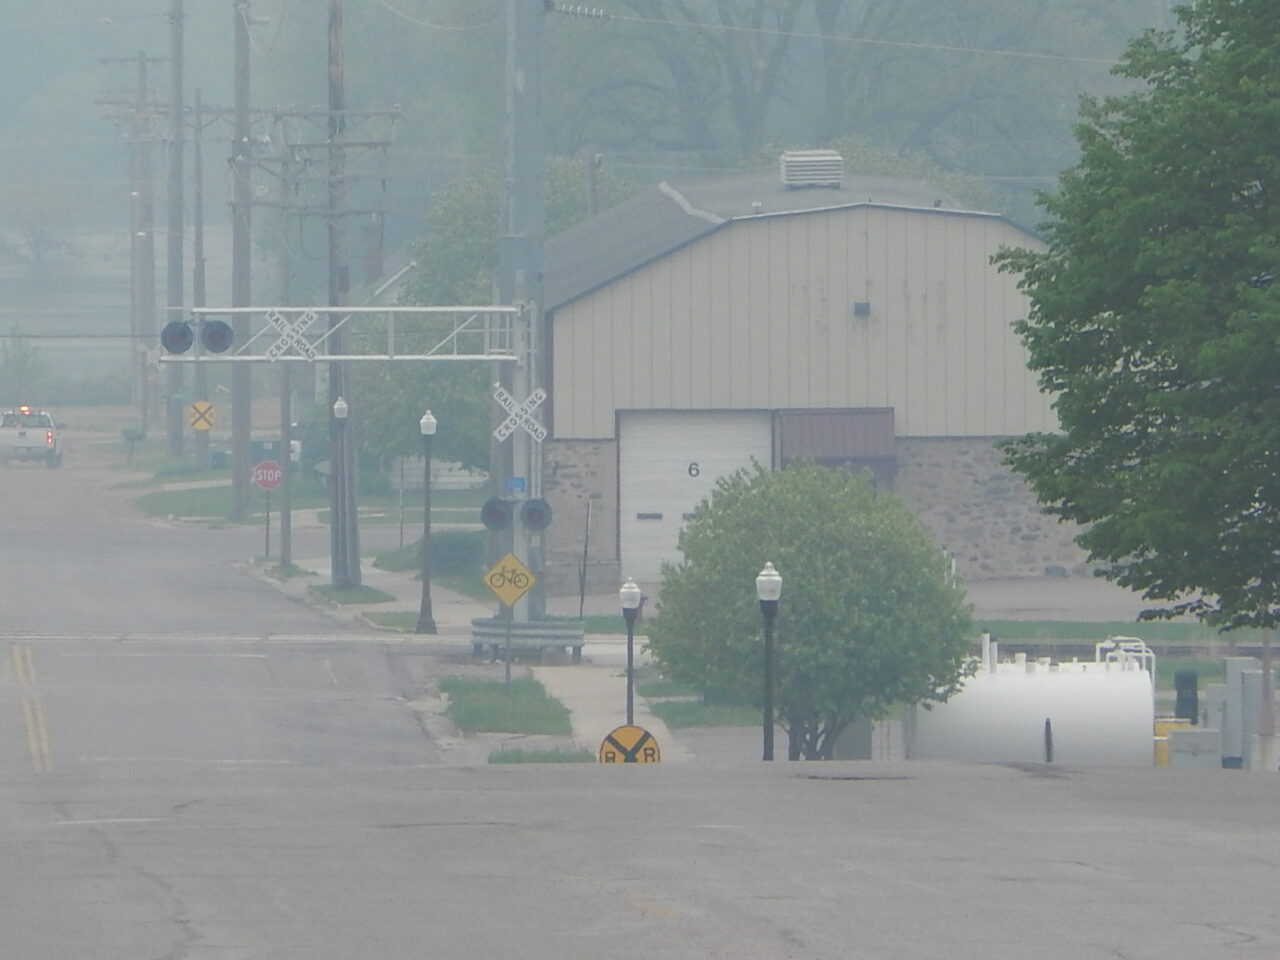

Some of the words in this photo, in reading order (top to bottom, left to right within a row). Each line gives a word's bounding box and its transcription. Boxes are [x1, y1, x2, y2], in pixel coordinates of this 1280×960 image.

[269, 311, 287, 332] RAIL
[294, 338, 316, 360] ROAD
[270, 313, 314, 358] CROSSING
[496, 391, 516, 411] RAIL
[523, 418, 544, 439] ROAD
[498, 392, 543, 438] CROSSING
[257, 470, 281, 481] STOP
[688, 462, 700, 477] 6
[643, 747, 656, 763] R
